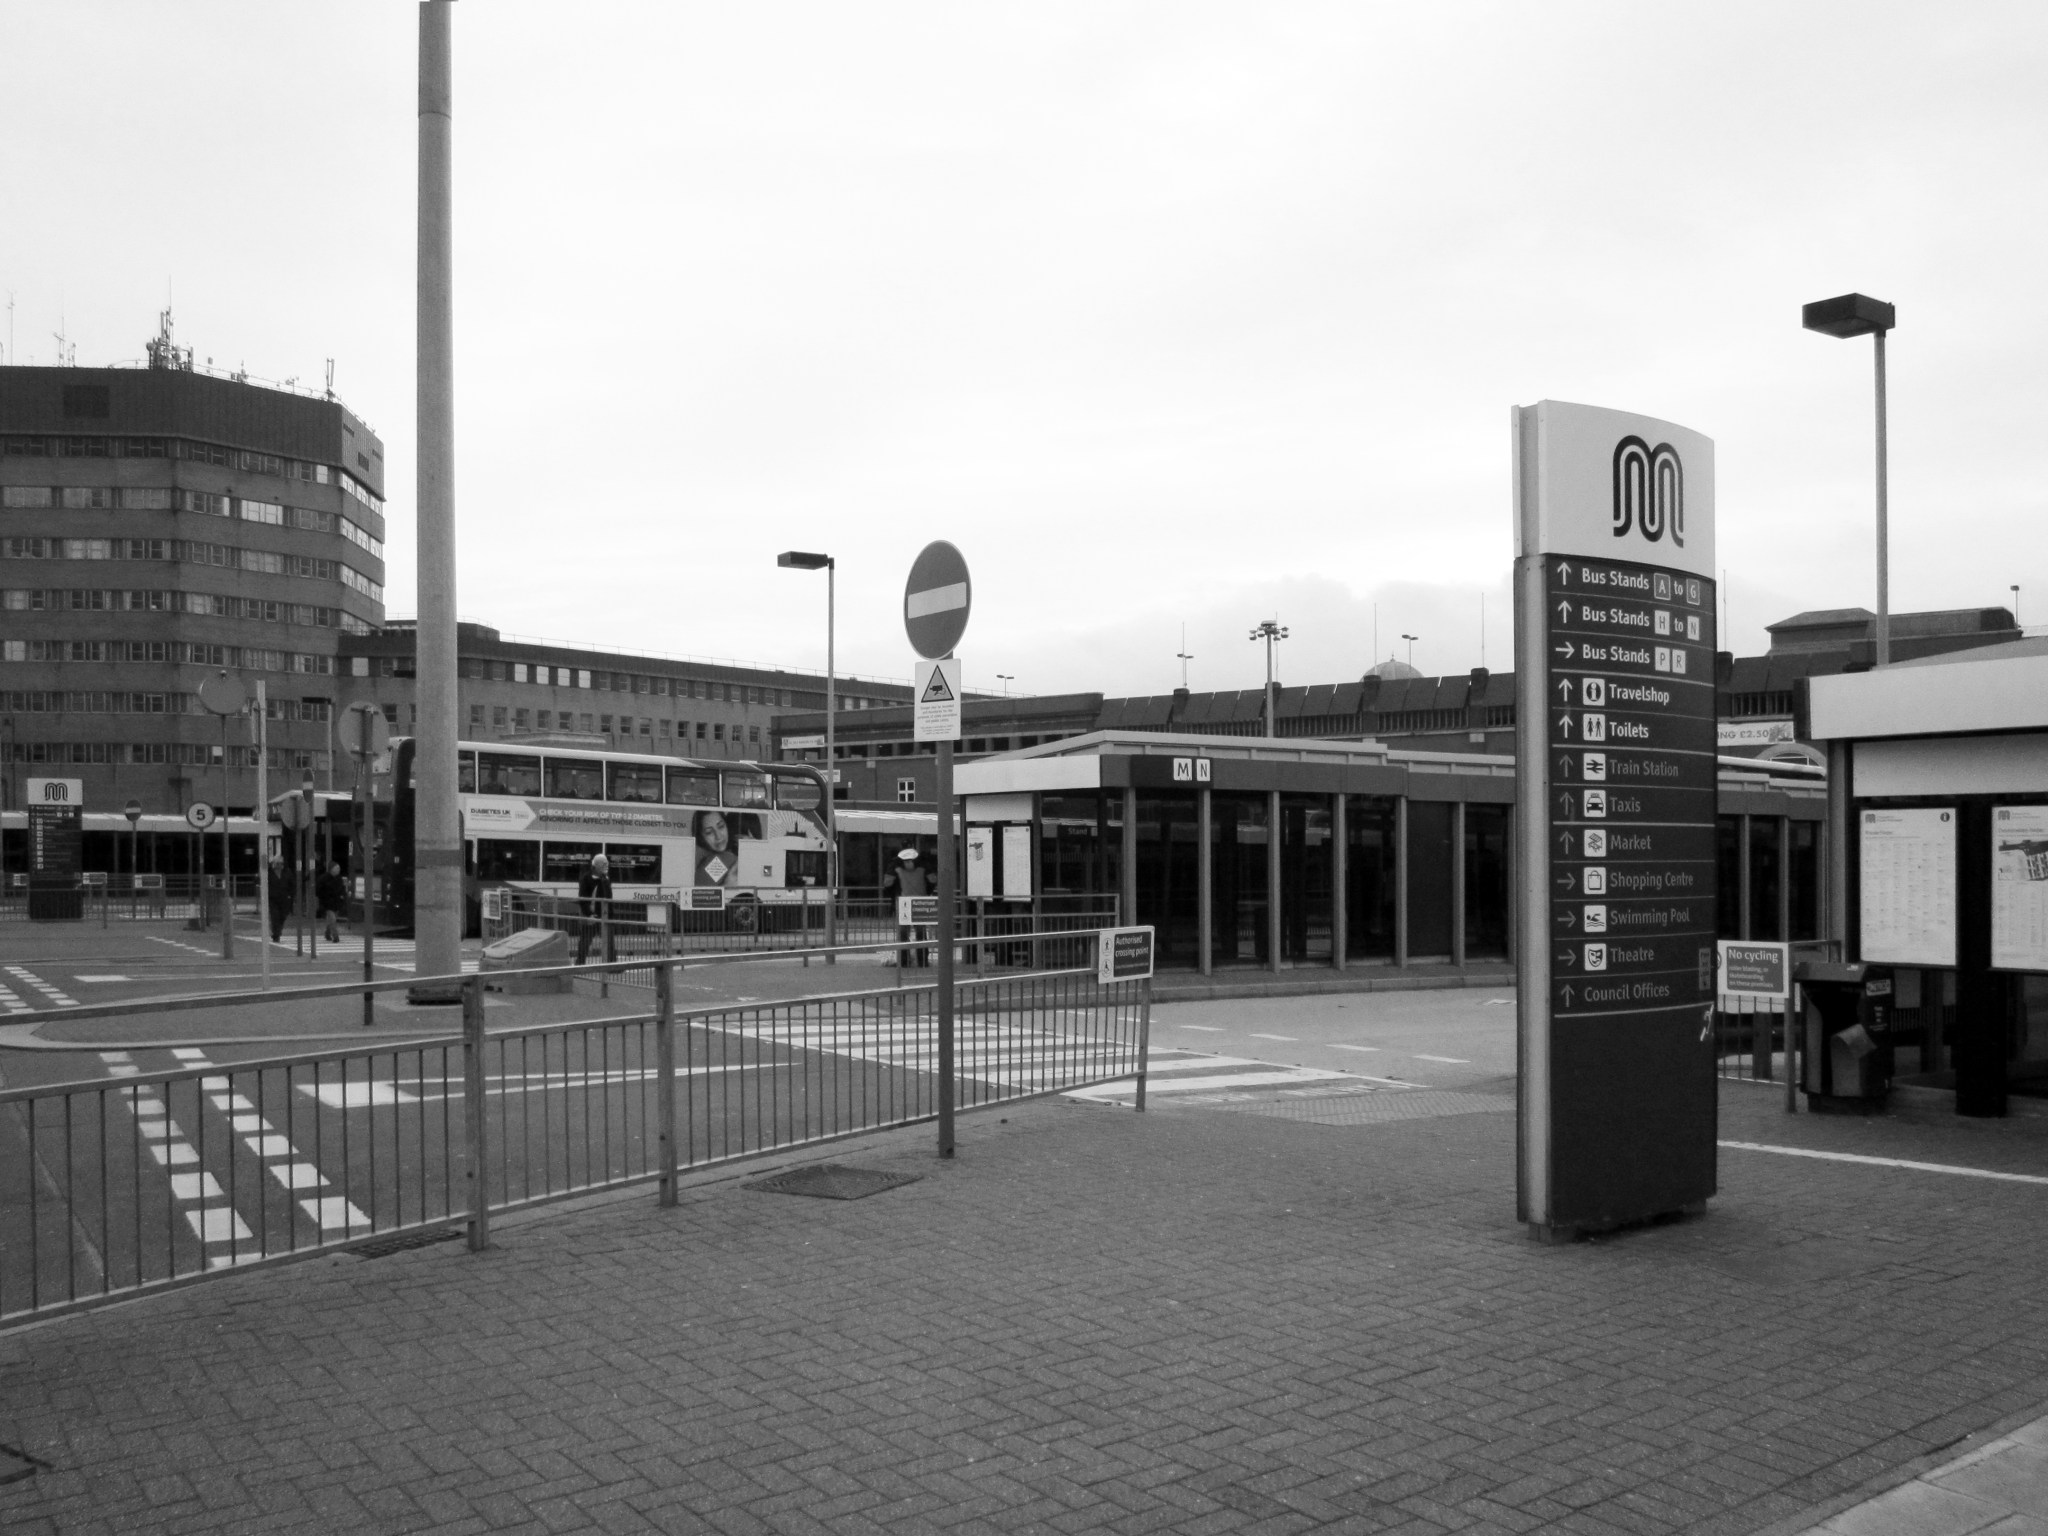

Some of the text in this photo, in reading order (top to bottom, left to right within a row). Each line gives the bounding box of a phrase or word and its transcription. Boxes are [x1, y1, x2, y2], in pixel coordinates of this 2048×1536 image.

[1582, 568, 1696, 599] Bus Stands A to G
[1582, 606, 1697, 636] Bus Stands H to N
[1582, 644, 1682, 668] Bus Stands P R
[1609, 684, 1670, 706] Travelshop
[1609, 721, 1649, 738] Toilets
[1740, 729, 1769, 738] £2.50
[1178, 762, 1207, 777] M N
[1610, 759, 1679, 777] Train Station
[1610, 796, 1641, 812] Taxis
[196, 809, 205, 821] 5
[1610, 834, 1651, 850] Market
[1610, 871, 1694, 890] Shopping Centre
[633, 892, 675, 901] Stagecach
[1610, 908, 1690, 926] Swimming Pool
[1116, 935, 1143, 945] Authorised
[1115, 947, 1149, 958] crossing point
[1611, 948, 1654, 963] Theatre
[1728, 949, 1778, 964] No cycling
[1584, 983, 1670, 1001] Council Offices
